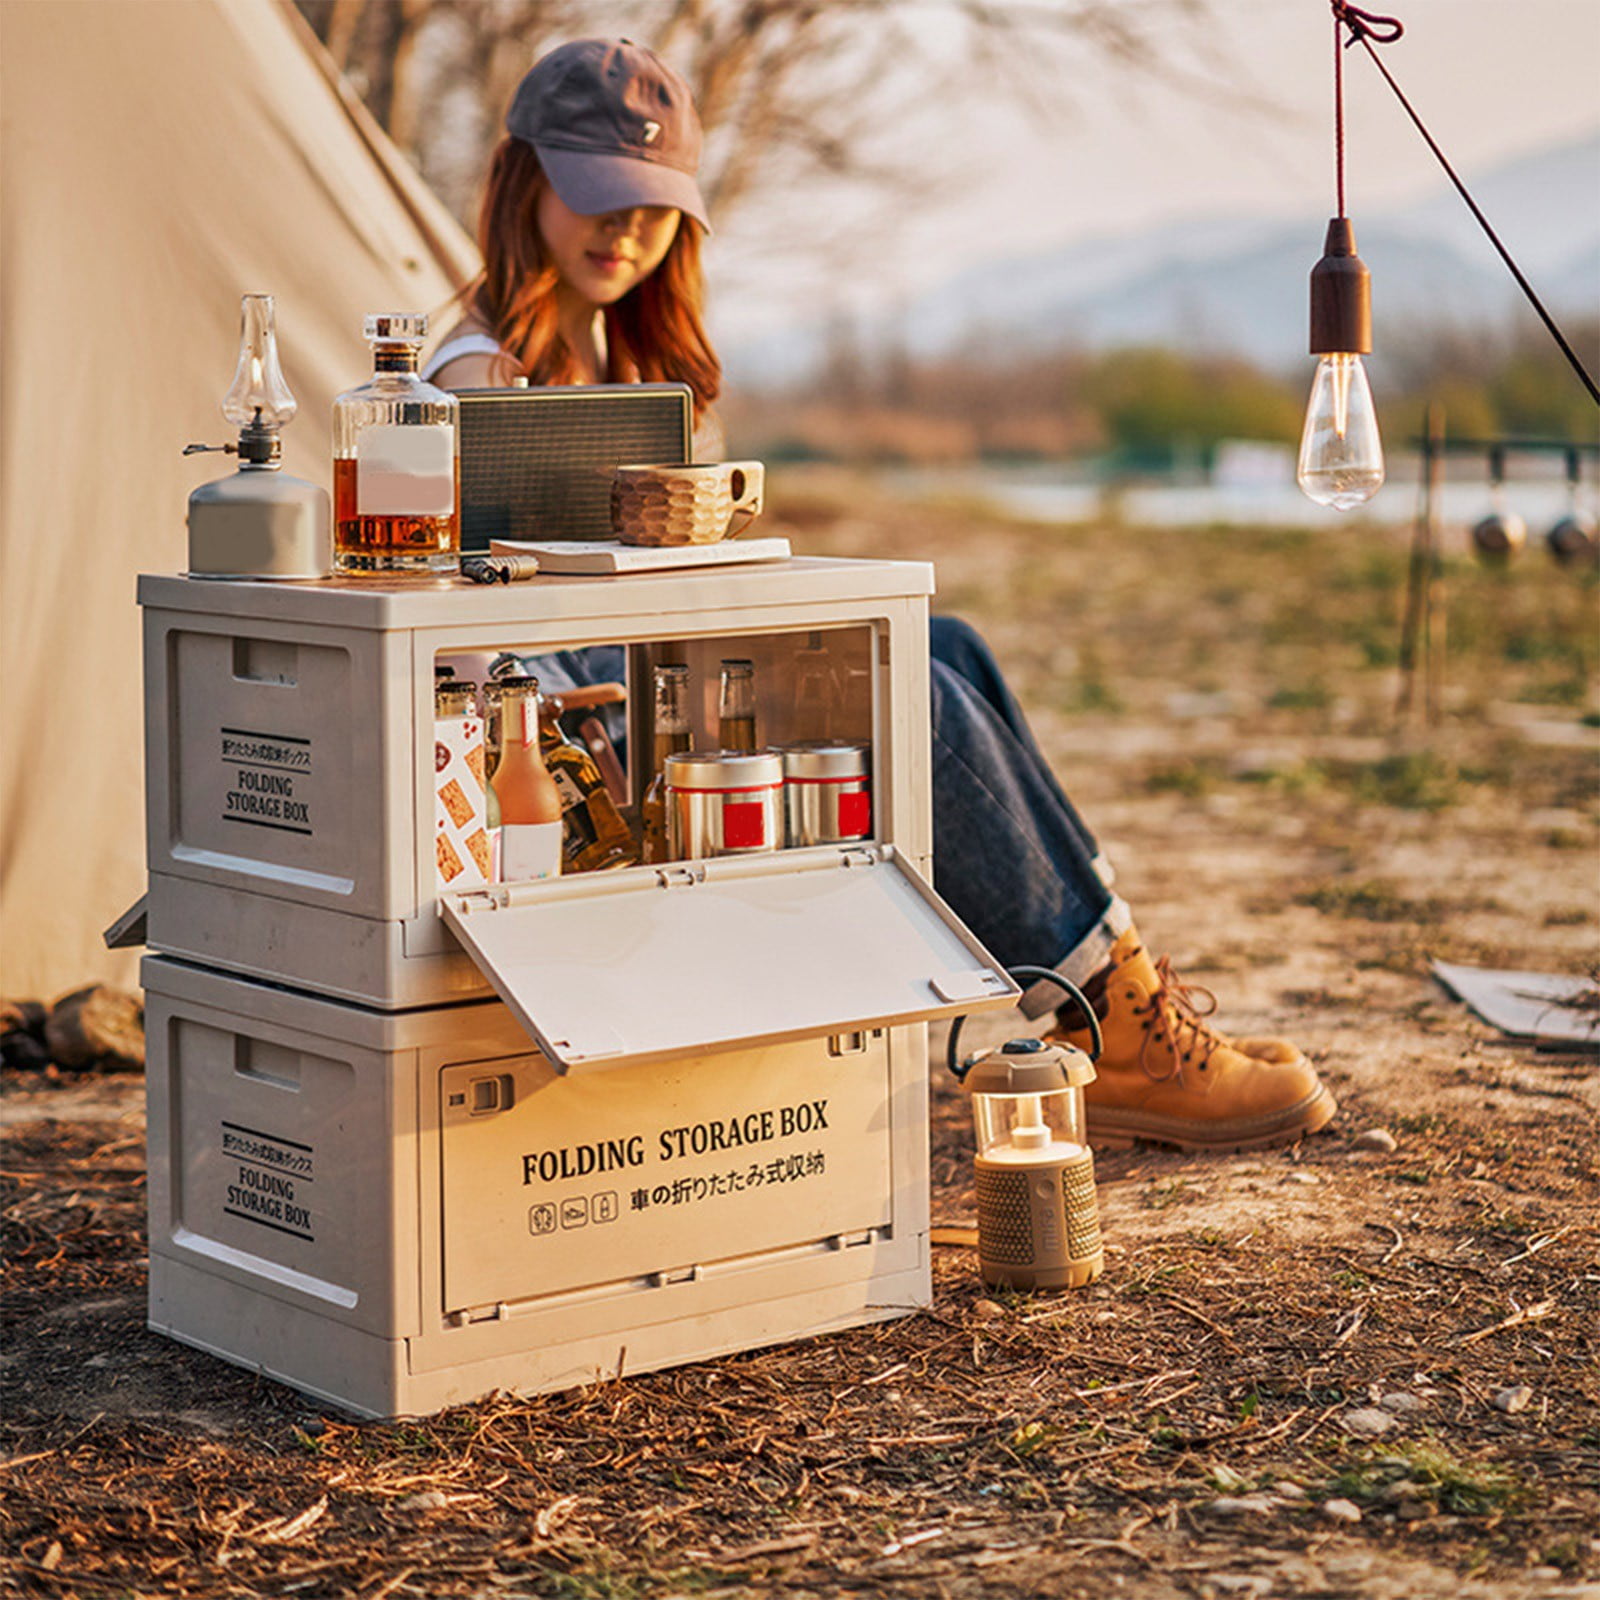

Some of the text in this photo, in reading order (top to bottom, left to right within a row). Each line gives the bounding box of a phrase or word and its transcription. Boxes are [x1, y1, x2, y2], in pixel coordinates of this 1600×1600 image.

[238, 770, 293, 797] FOLDING
[226, 791, 309, 823] STORAGE BOX
[522, 1099, 829, 1186] FOLDING STORAGE BOX
[239, 1166, 294, 1201] FOLDING
[630, 1149, 826, 1211] 車の折りたたみ式収納
[227, 1184, 311, 1229] STORAGE BOX
